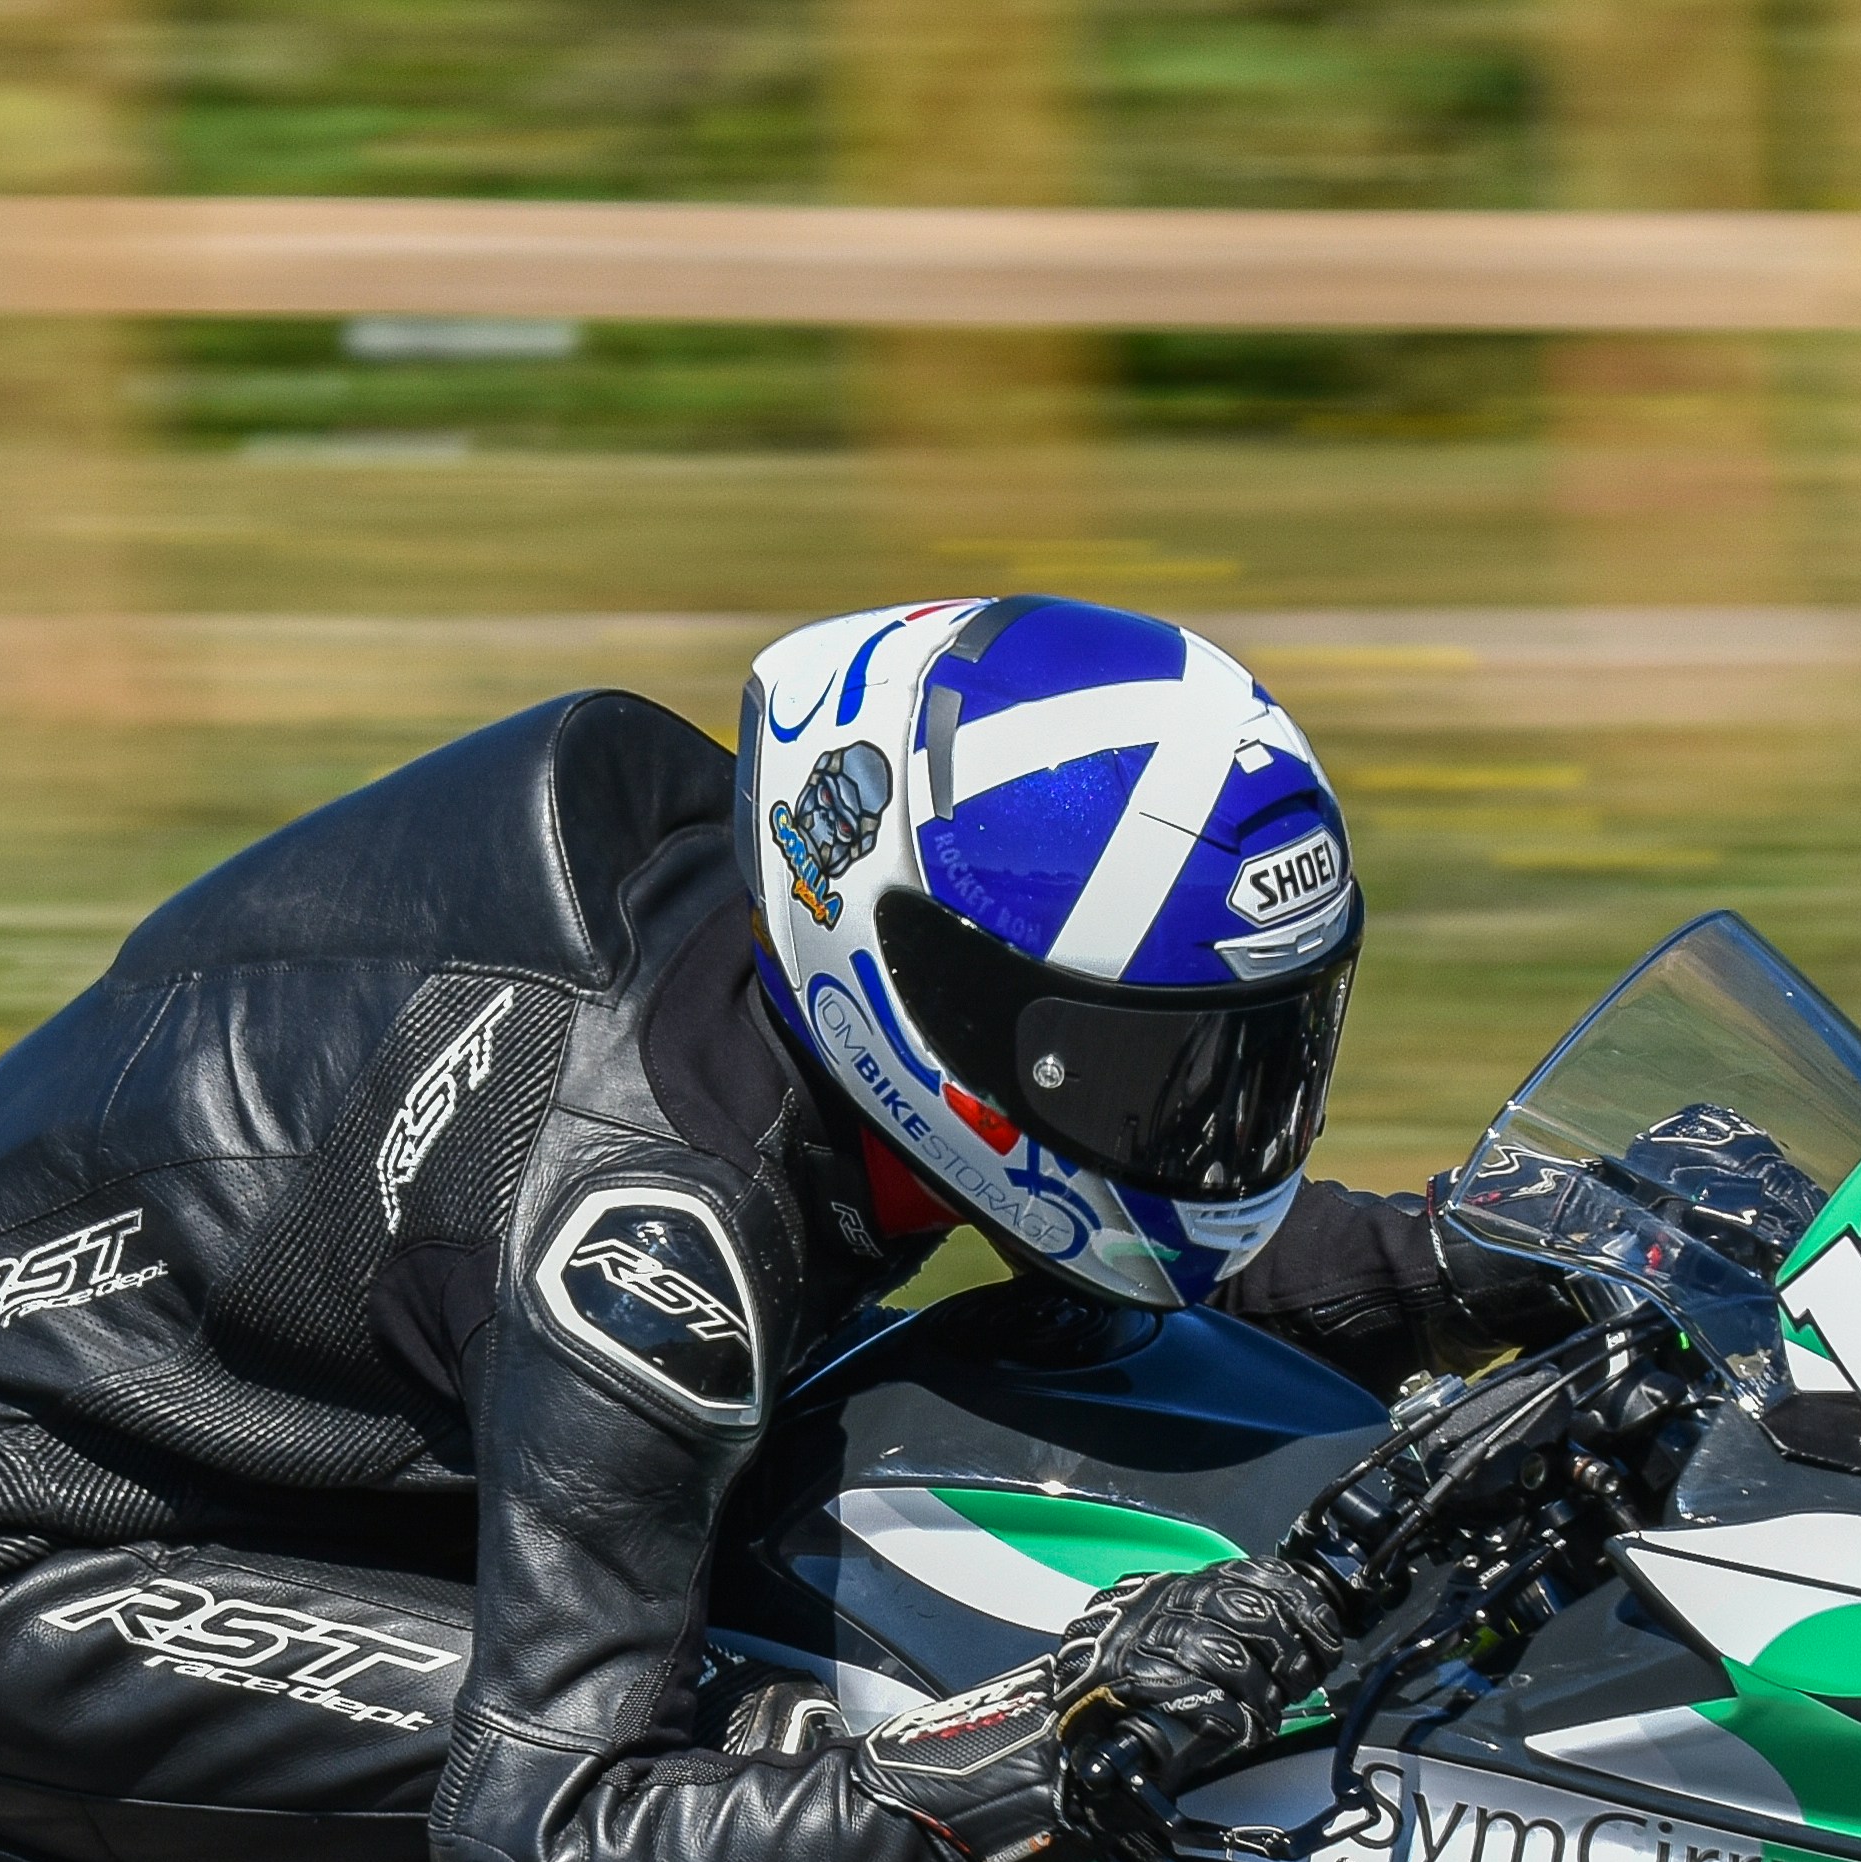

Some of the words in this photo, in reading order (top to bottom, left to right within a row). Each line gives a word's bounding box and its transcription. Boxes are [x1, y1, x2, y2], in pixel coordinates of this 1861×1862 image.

[1249, 840, 1336, 912] SHOEI
[376, 985, 515, 1236] RST
[569, 1238, 753, 1354] RST
[38, 1577, 464, 1690] RST
[141, 1654, 289, 1696] race
[287, 1683, 435, 1732] dept
